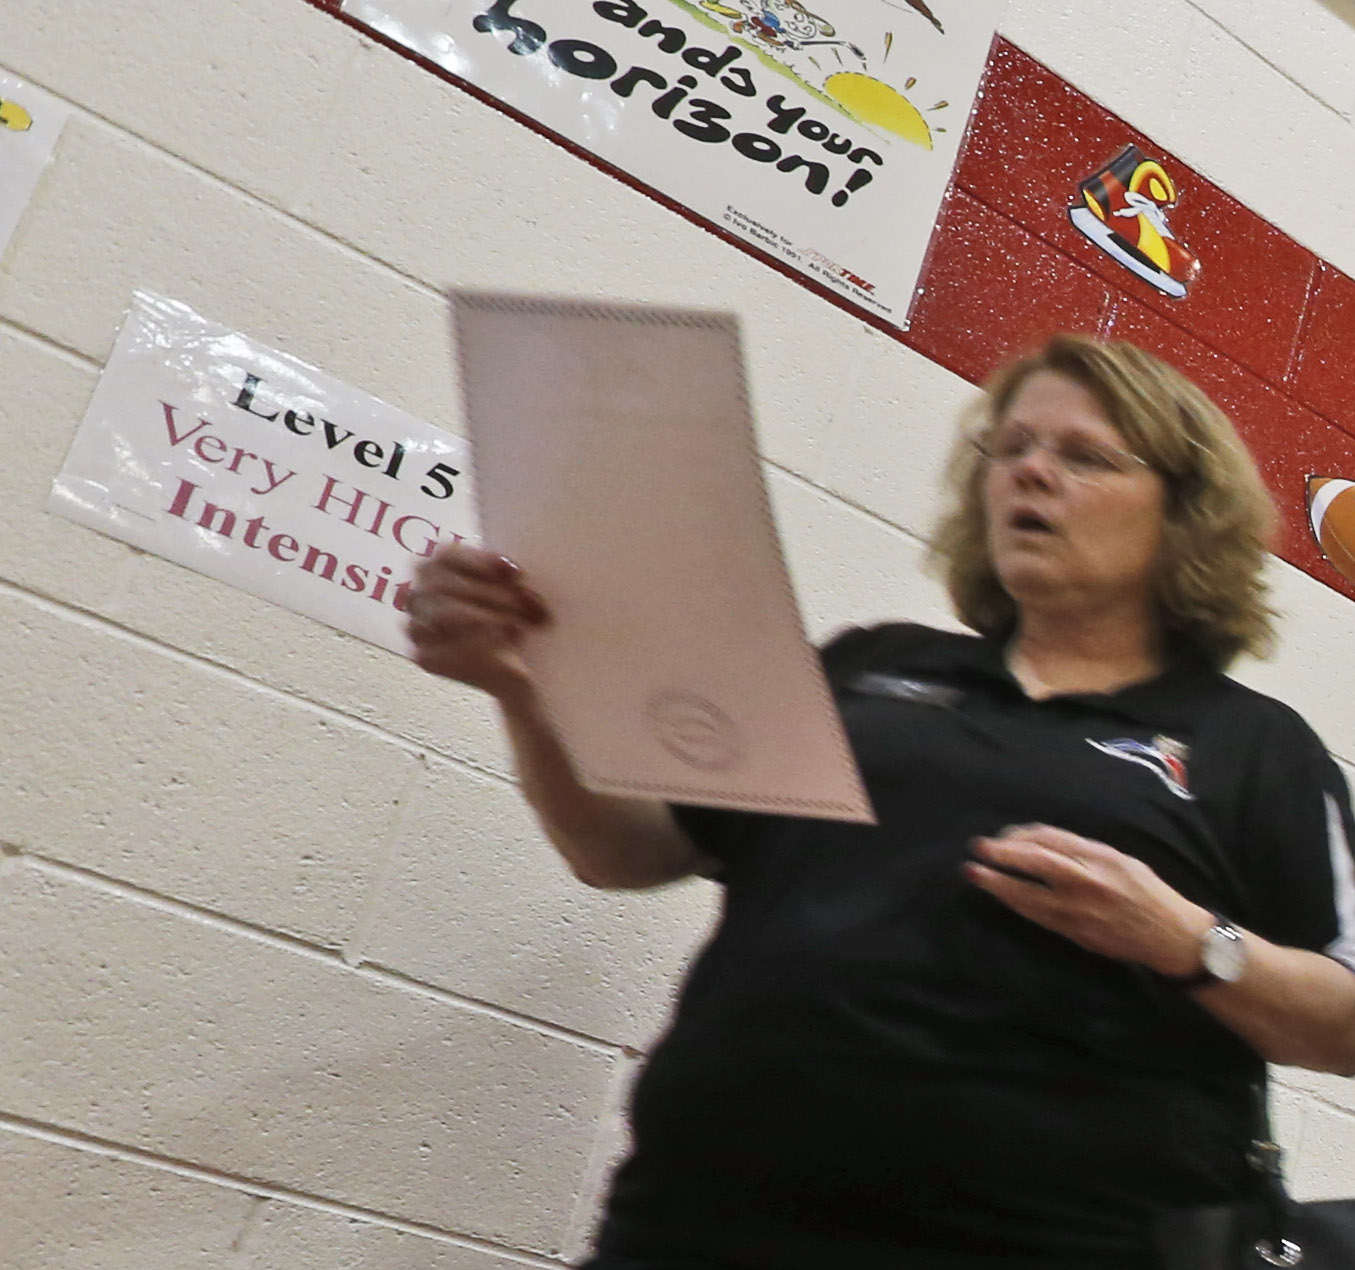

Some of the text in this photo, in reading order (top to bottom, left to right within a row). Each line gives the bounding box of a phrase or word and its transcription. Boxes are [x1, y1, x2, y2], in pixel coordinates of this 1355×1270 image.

[766, 94, 884, 167] your
[158, 400, 469, 559] Very HIG
[230, 372, 460, 499] Level 5
[162, 475, 413, 612] Intensit
